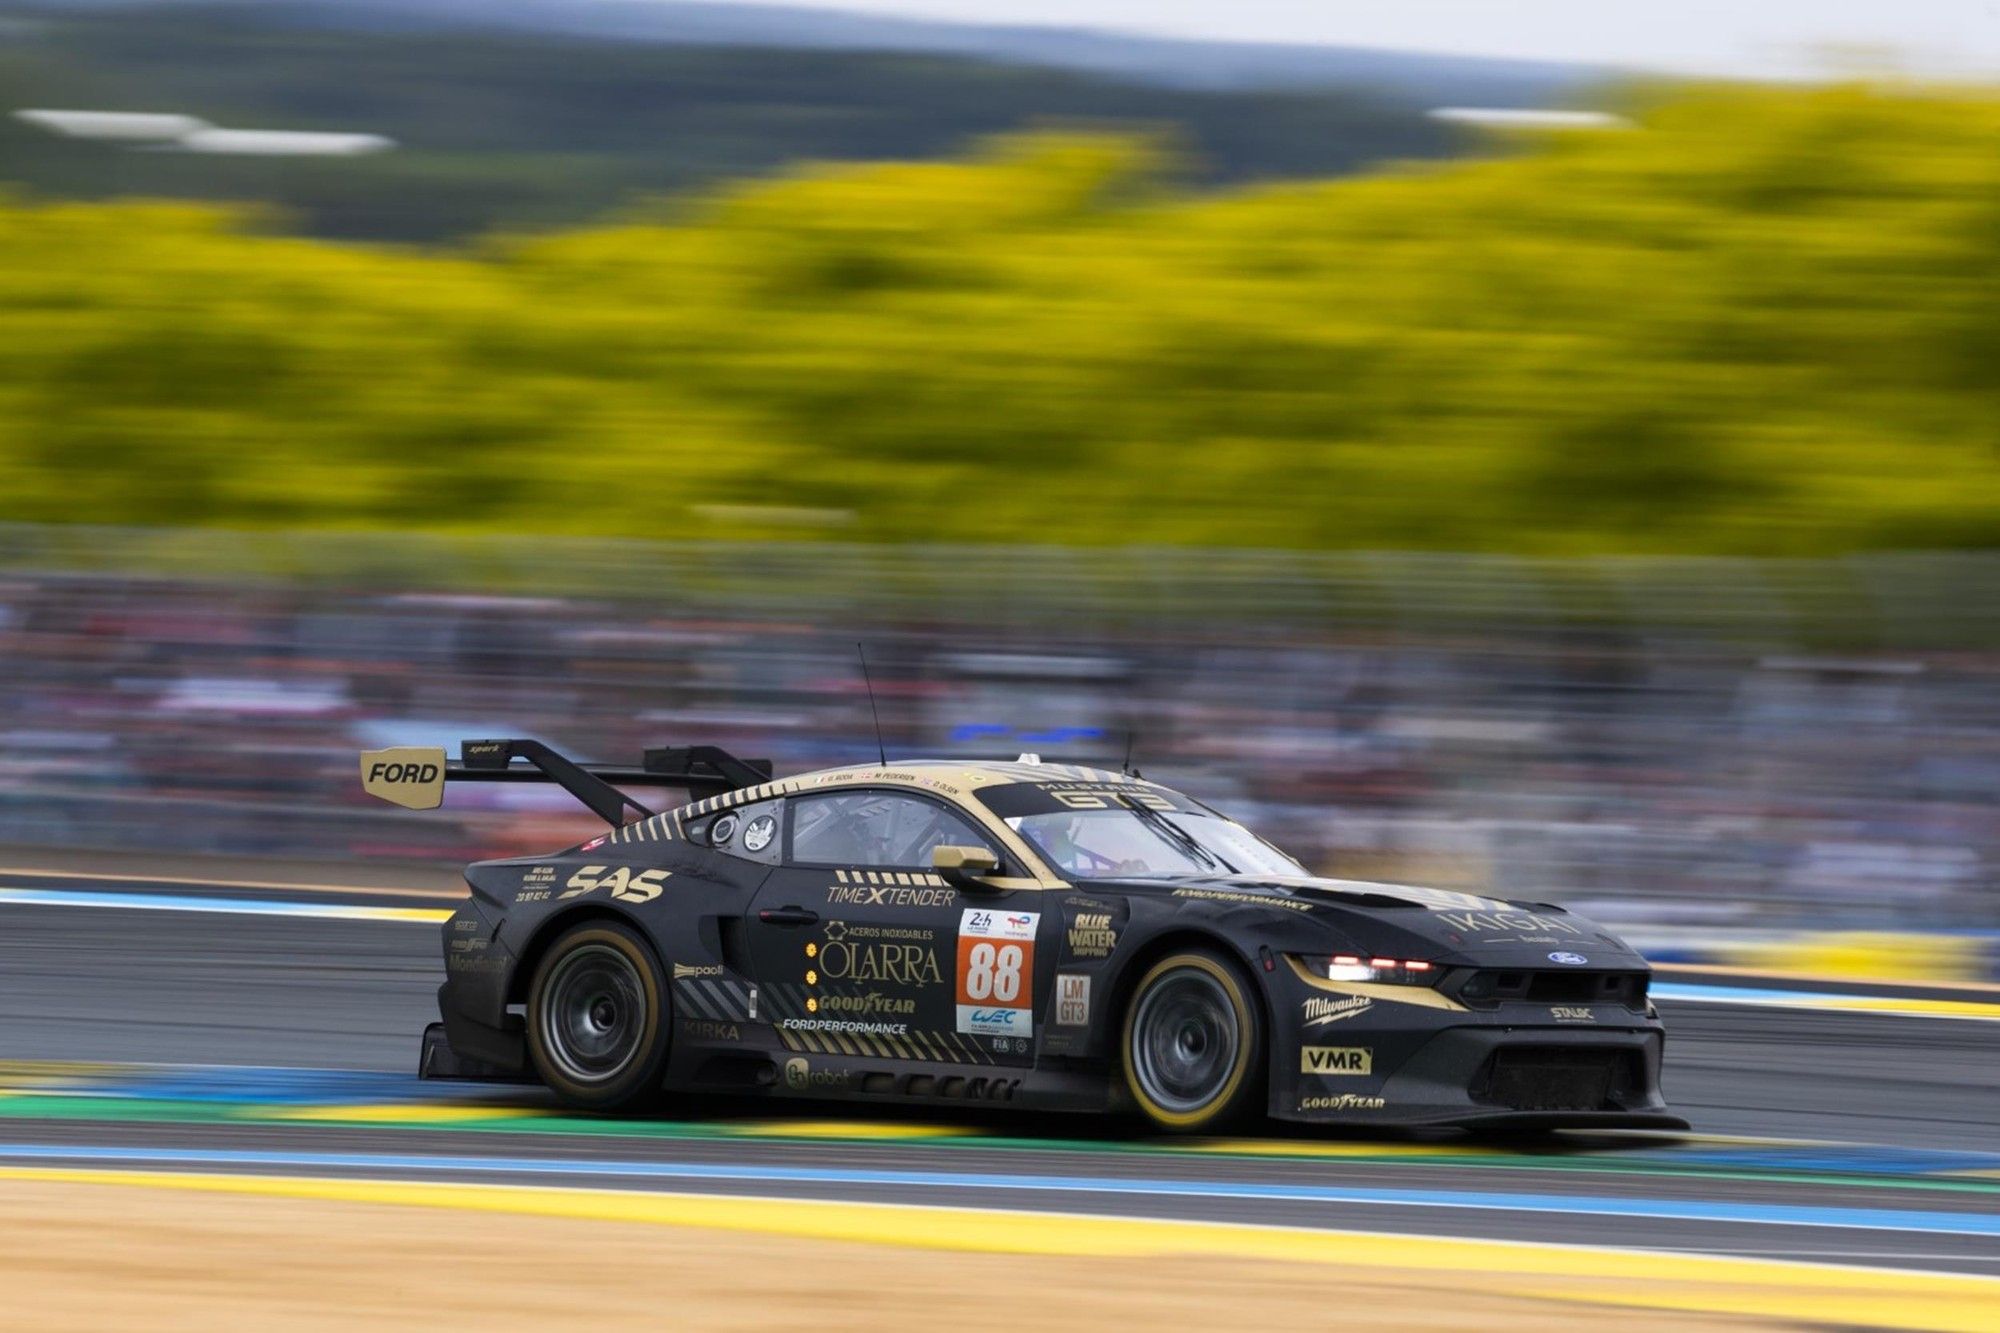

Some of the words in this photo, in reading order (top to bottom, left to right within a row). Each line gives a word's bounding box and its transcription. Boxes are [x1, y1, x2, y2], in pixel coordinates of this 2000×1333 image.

[368, 763, 439, 784] FORD
[883, 773, 916, 781] PEDERSEN
[557, 865, 674, 904] SAS
[826, 886, 956, 907] TIMEXTENDER
[1074, 913, 1112, 930] BLUE
[1436, 912, 1582, 936] IKIGAI
[849, 927, 880, 938] ACEROS
[881, 928, 934, 940] INOXIDABLES
[1068, 929, 1117, 948] WATER
[966, 942, 1024, 1002] 88
[1063, 979, 1084, 999] LM
[971, 1010, 1017, 1025] WEC
[1060, 1001, 1086, 1022] GT3
[1301, 995, 1372, 1020] Milwaukee
[1308, 1050, 1363, 1070] VMR
[1302, 1093, 1386, 1110] GOODYEAR
